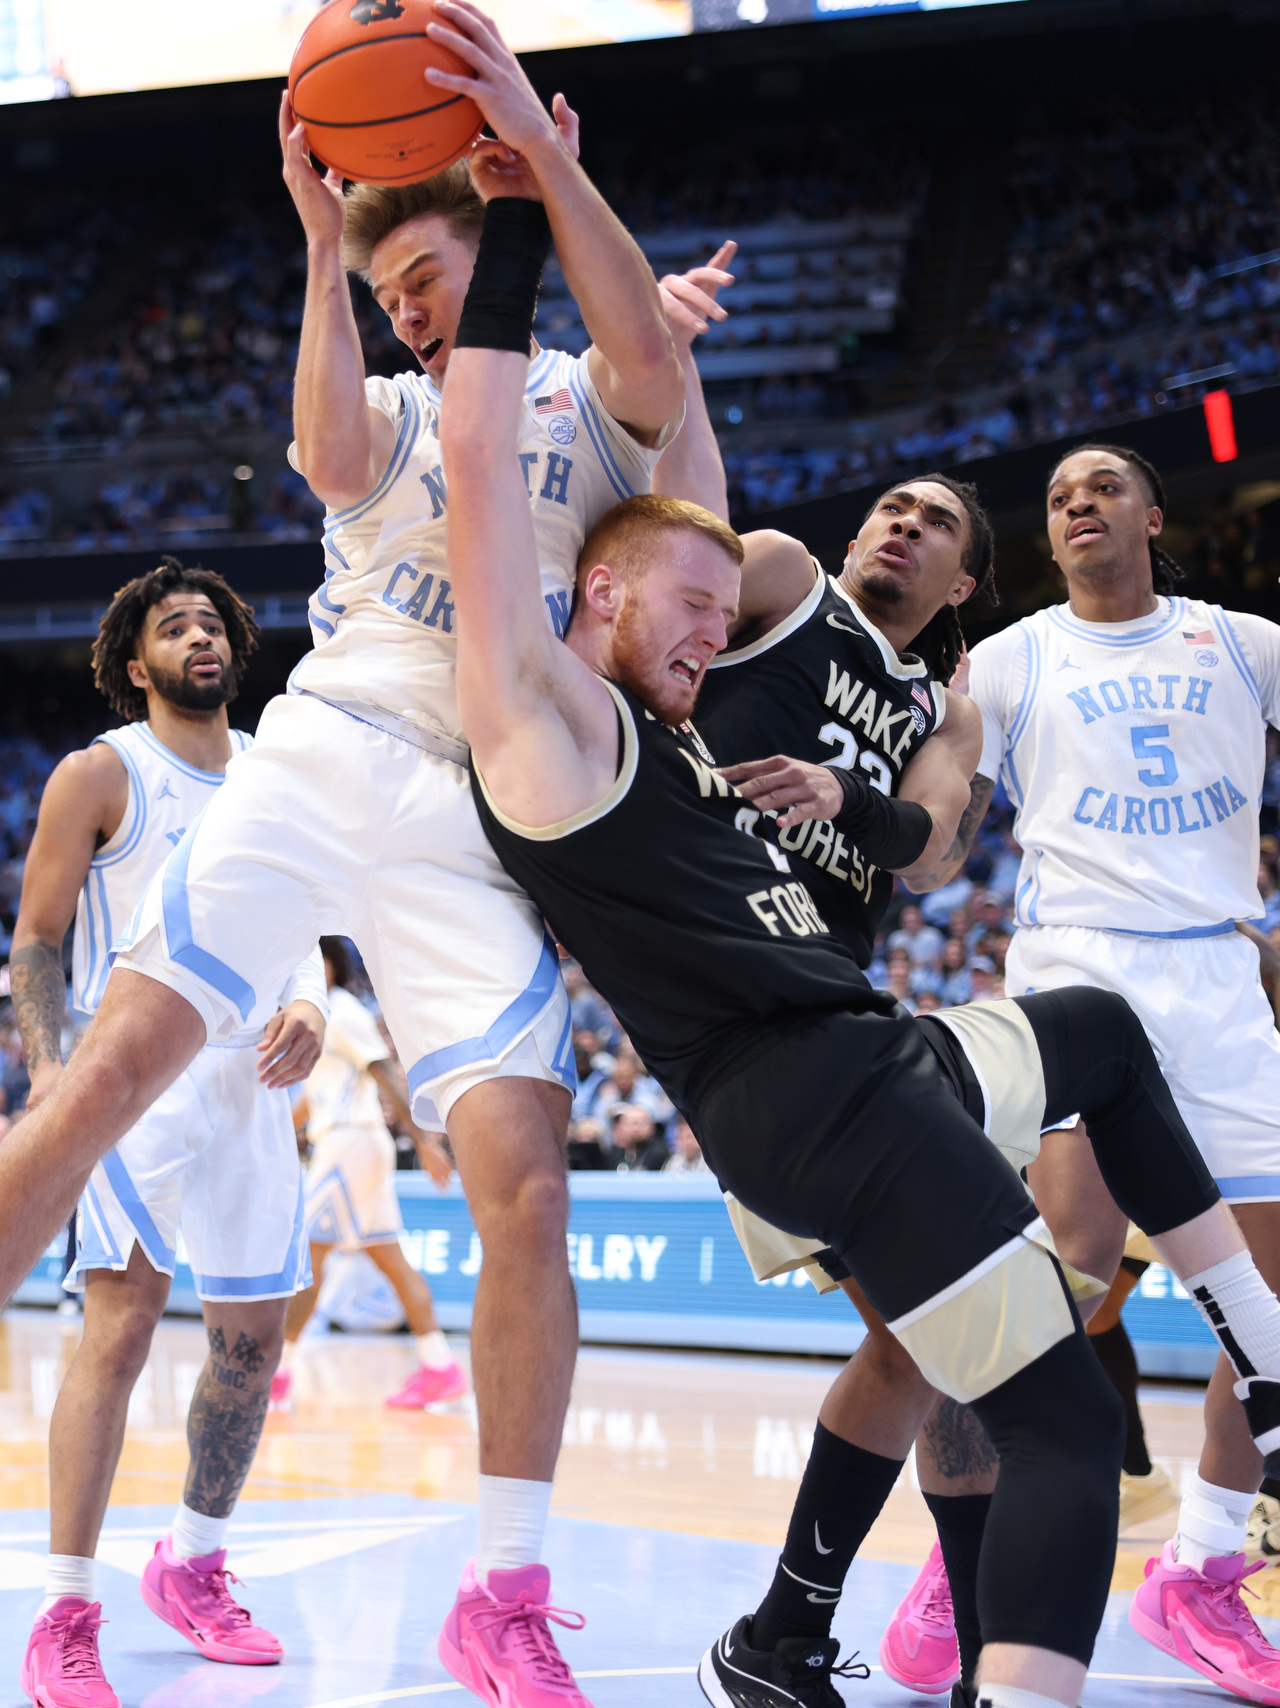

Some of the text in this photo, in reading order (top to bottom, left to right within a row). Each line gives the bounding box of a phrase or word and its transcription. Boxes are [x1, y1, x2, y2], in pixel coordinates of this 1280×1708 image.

[420, 452, 573, 519] NTH
[382, 562, 568, 642] CARN
[823, 659, 916, 772] WAKE
[1066, 674, 1213, 725] NORTH
[1130, 724, 1179, 788] 5
[1073, 775, 1248, 836] CAROLINA
[763, 807, 881, 904] OREST
[397, 1228, 450, 1274] NE
